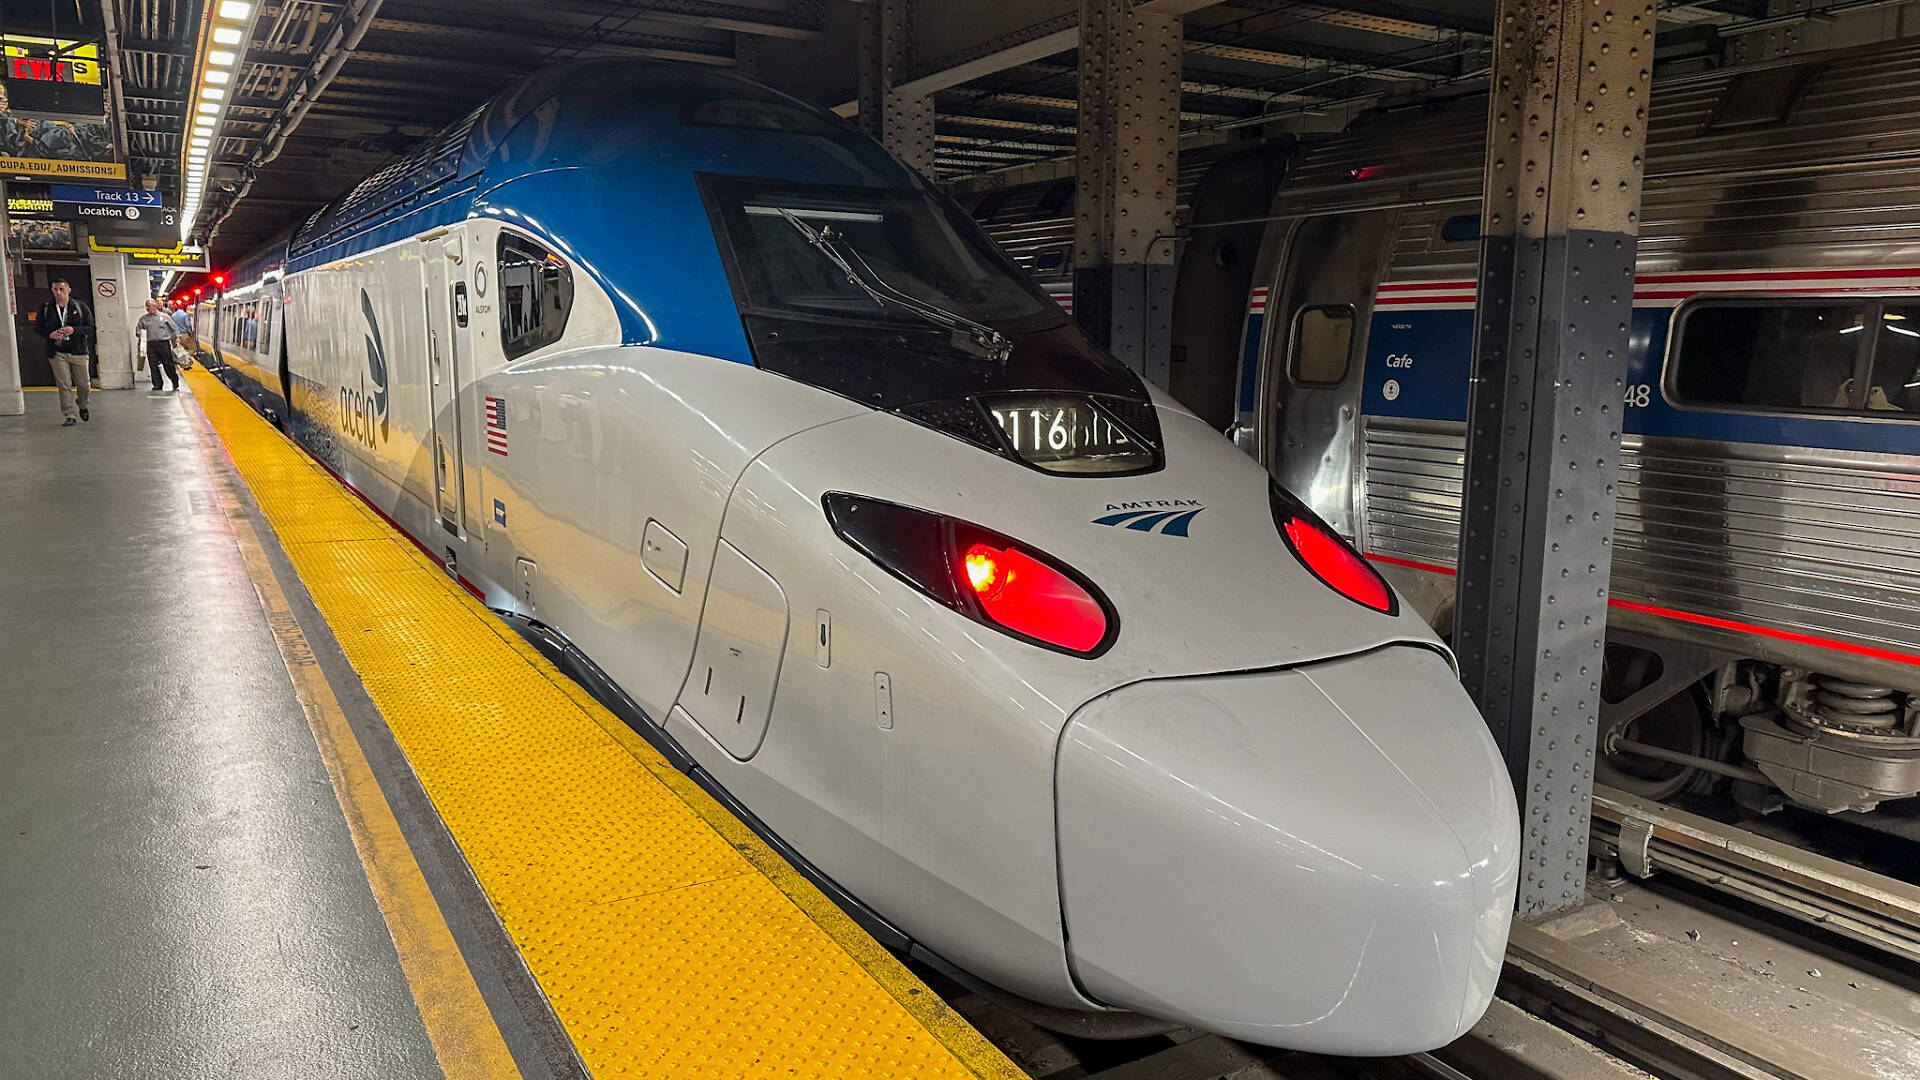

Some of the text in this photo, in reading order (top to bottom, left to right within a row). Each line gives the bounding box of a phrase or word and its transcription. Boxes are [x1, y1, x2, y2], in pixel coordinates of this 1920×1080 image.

[94, 190, 139, 202] Track 13
[78, 205, 122, 217] Location
[1386, 353, 1413, 369] Cafe
[1624, 384, 1651, 408] 48
[340, 370, 377, 451] acela
[1106, 499, 1203, 511] AMTRAK
